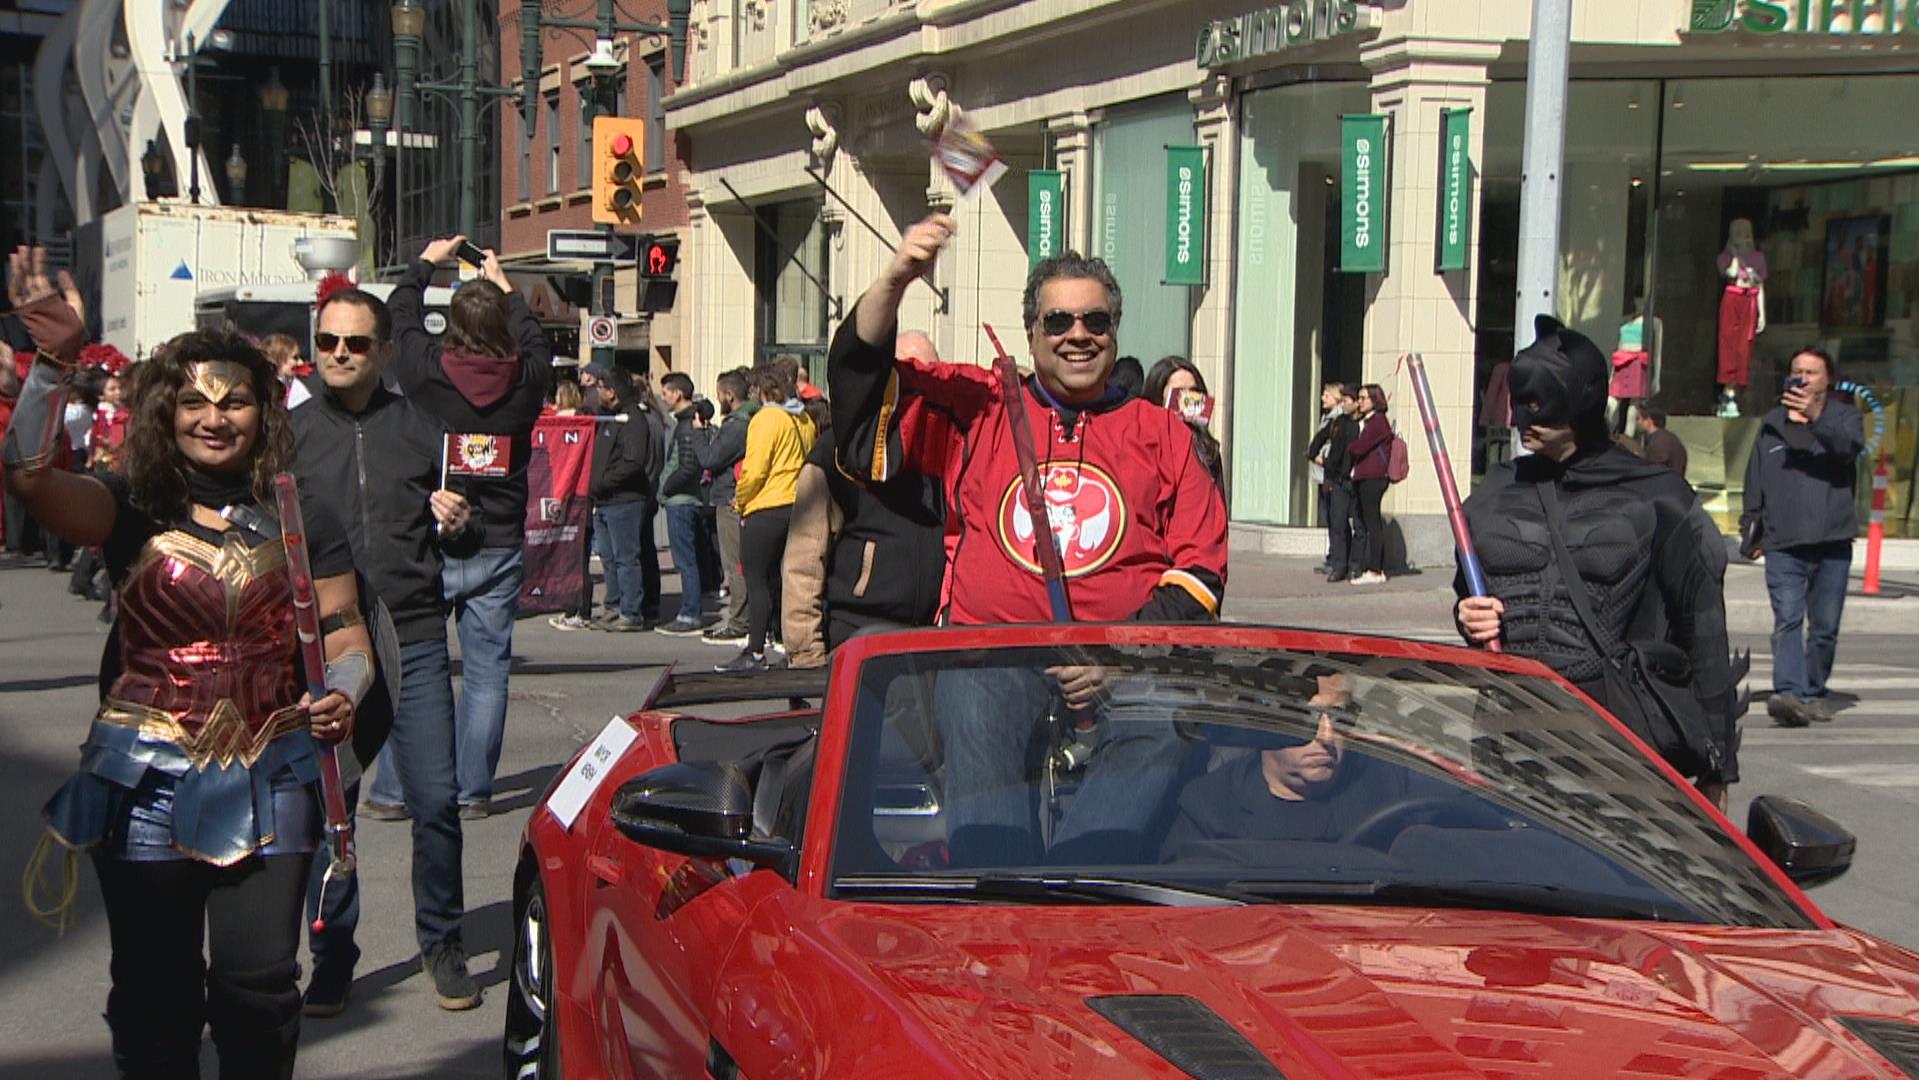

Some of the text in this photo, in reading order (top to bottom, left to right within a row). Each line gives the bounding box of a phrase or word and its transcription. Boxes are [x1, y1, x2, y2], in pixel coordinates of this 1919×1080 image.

[1216, 0, 1358, 62] simons
[1039, 202, 1051, 257] simo
[1177, 180, 1192, 265] simons
[1355, 154, 1370, 249] simons
[1449, 151, 1461, 245] simons
[200, 267, 302, 287] IRON MOUNT
